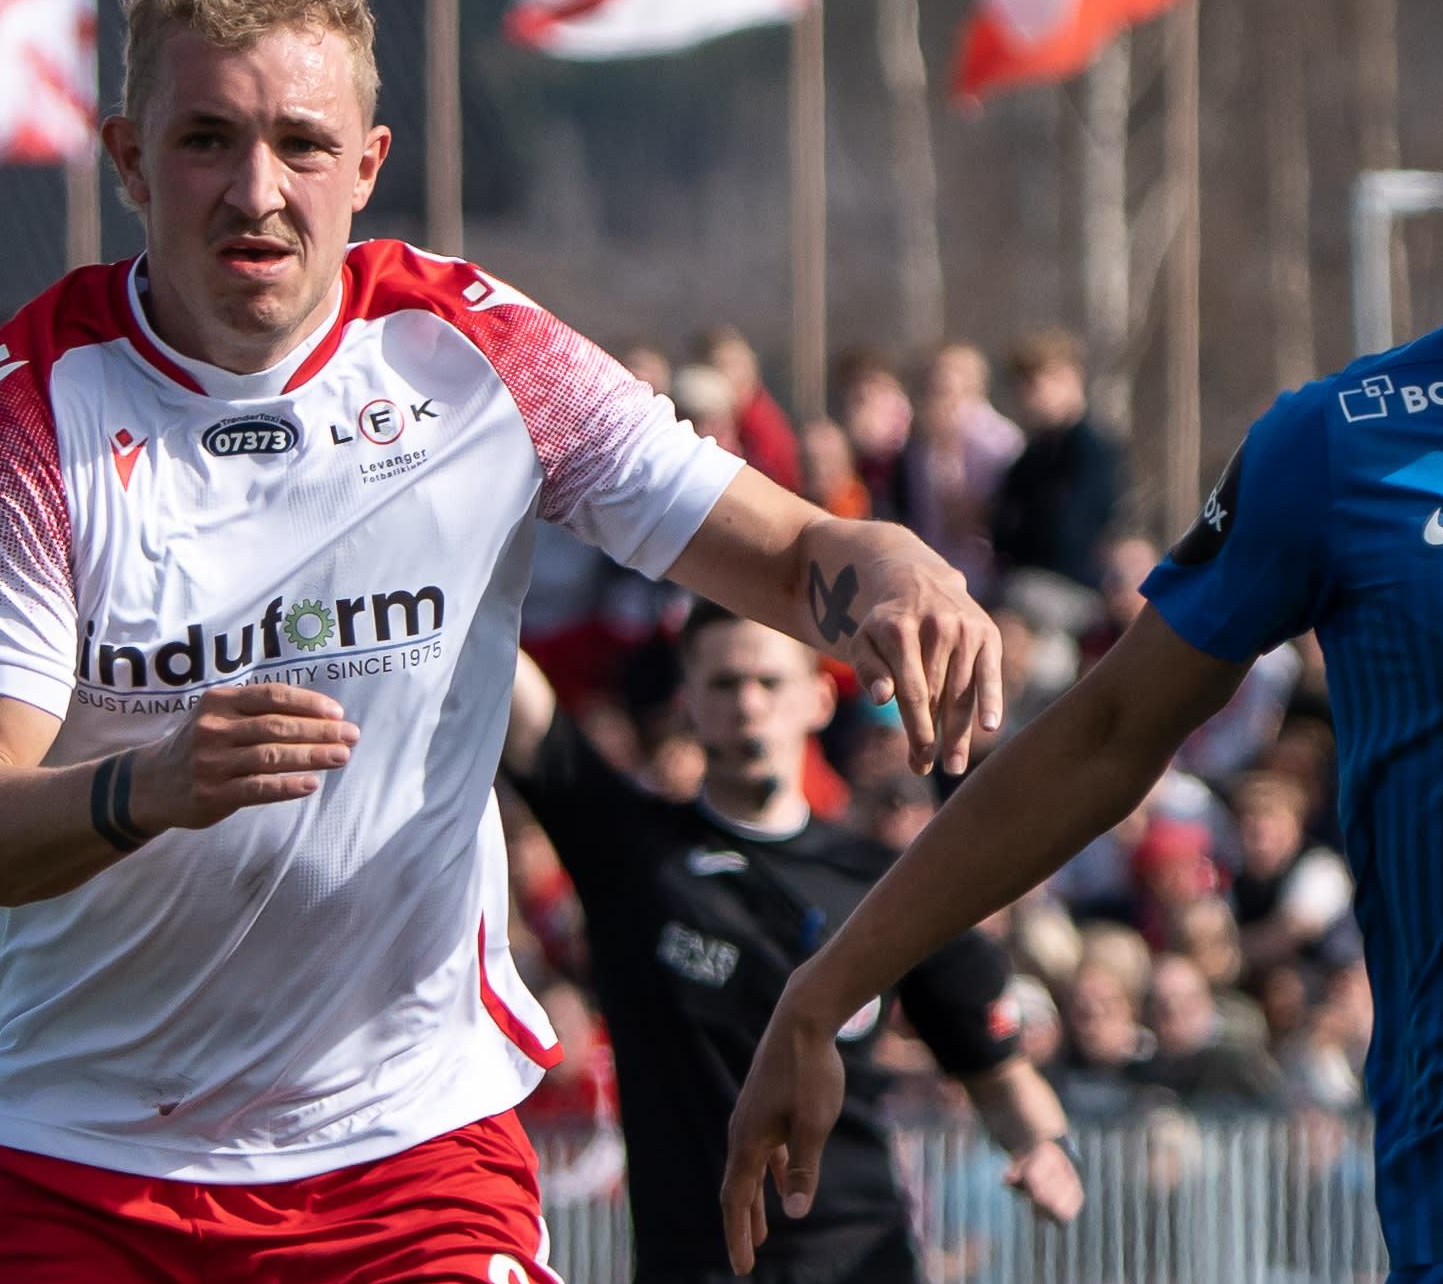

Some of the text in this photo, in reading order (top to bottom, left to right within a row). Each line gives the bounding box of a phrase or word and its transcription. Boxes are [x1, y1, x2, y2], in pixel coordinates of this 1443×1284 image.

[215, 430, 287, 453] 07373
[359, 449, 426, 474] Levanger
[77, 584, 446, 688] induform
[326, 655, 393, 681] SINCE
[400, 641, 443, 670] 1975
